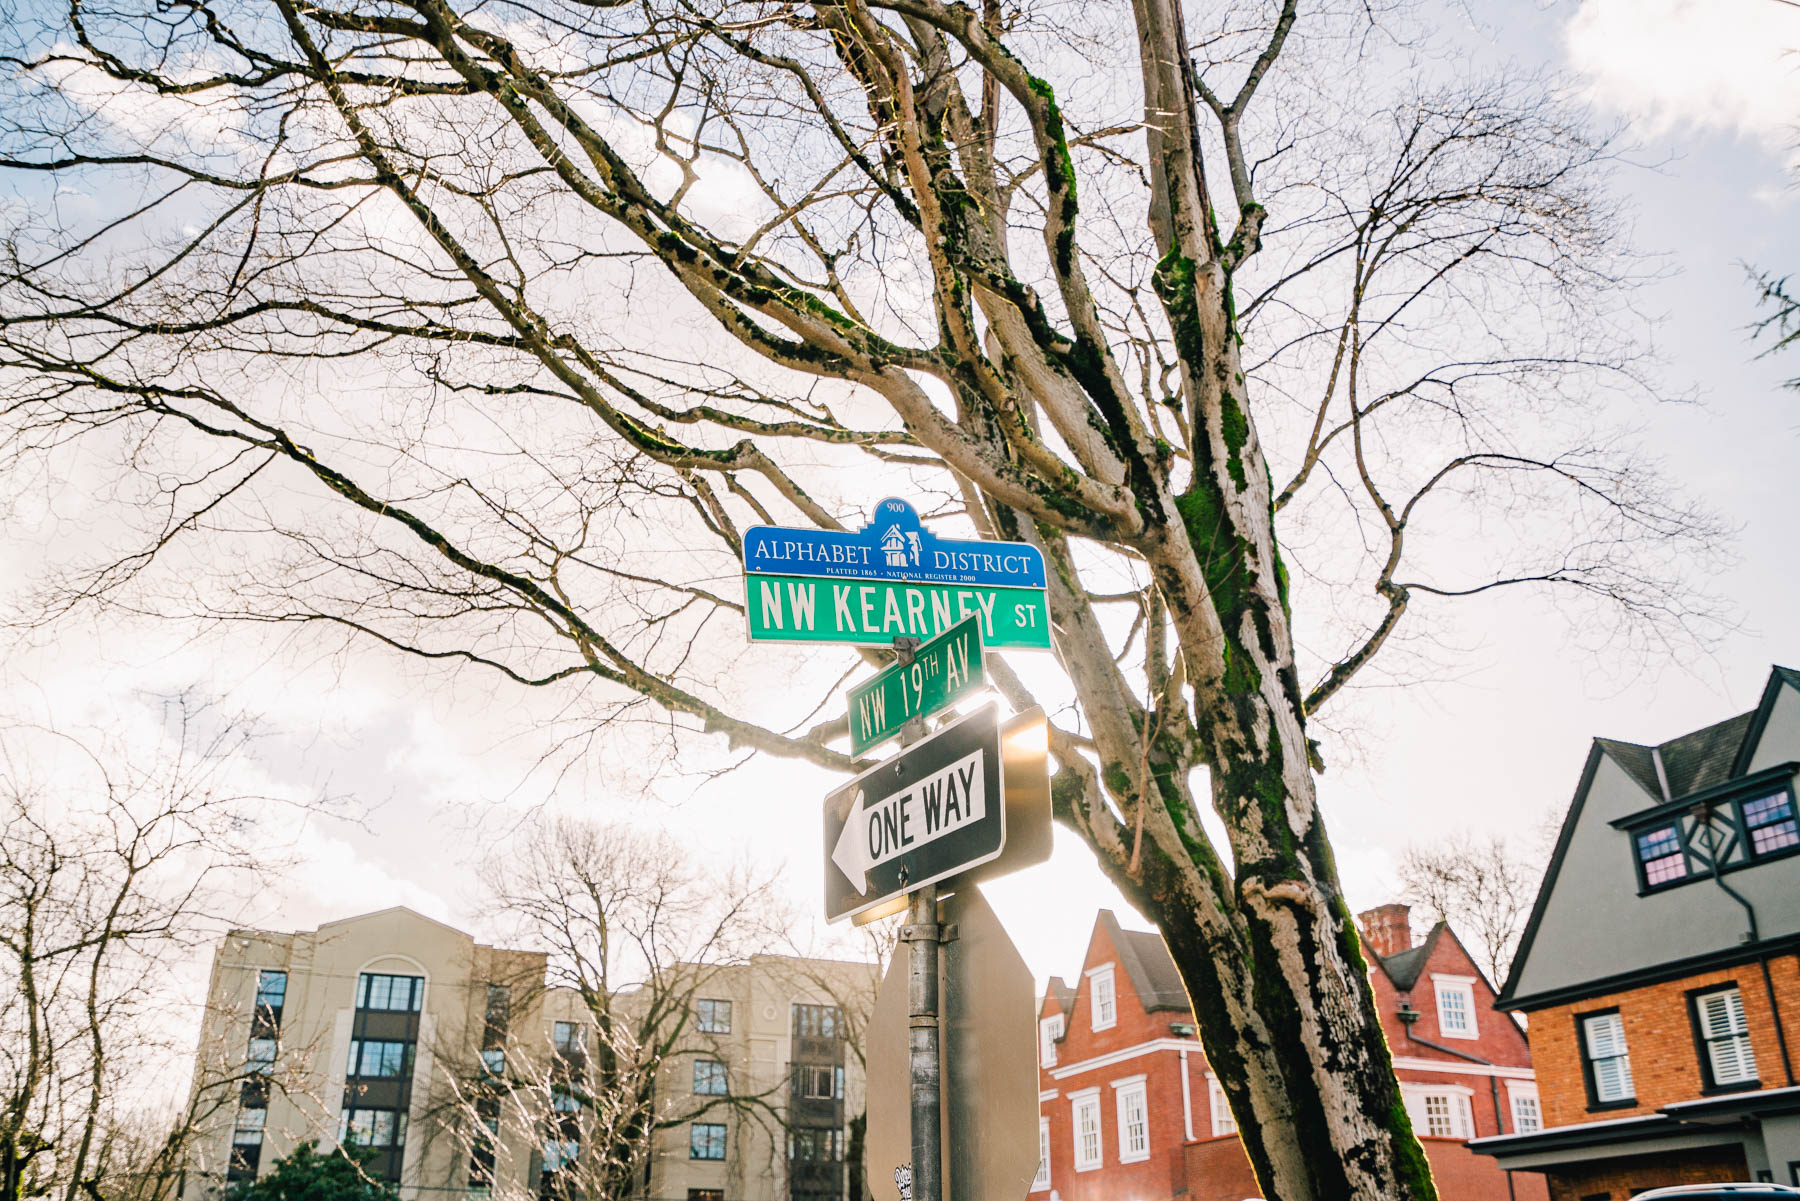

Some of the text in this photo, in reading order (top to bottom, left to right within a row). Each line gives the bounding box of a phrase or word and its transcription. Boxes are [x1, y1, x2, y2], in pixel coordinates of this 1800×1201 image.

[886, 502, 905, 513] 900
[754, 539, 1031, 575] ALPHABET DISTRICT
[826, 567, 858, 575] PLATTED
[886, 570, 922, 579] NATIONAL
[925, 573, 957, 581] REGISTER
[760, 581, 1037, 638] NW KEARNEY ST
[860, 632, 969, 741] NW 19TH AV
[868, 761, 976, 860] ONE WAY
